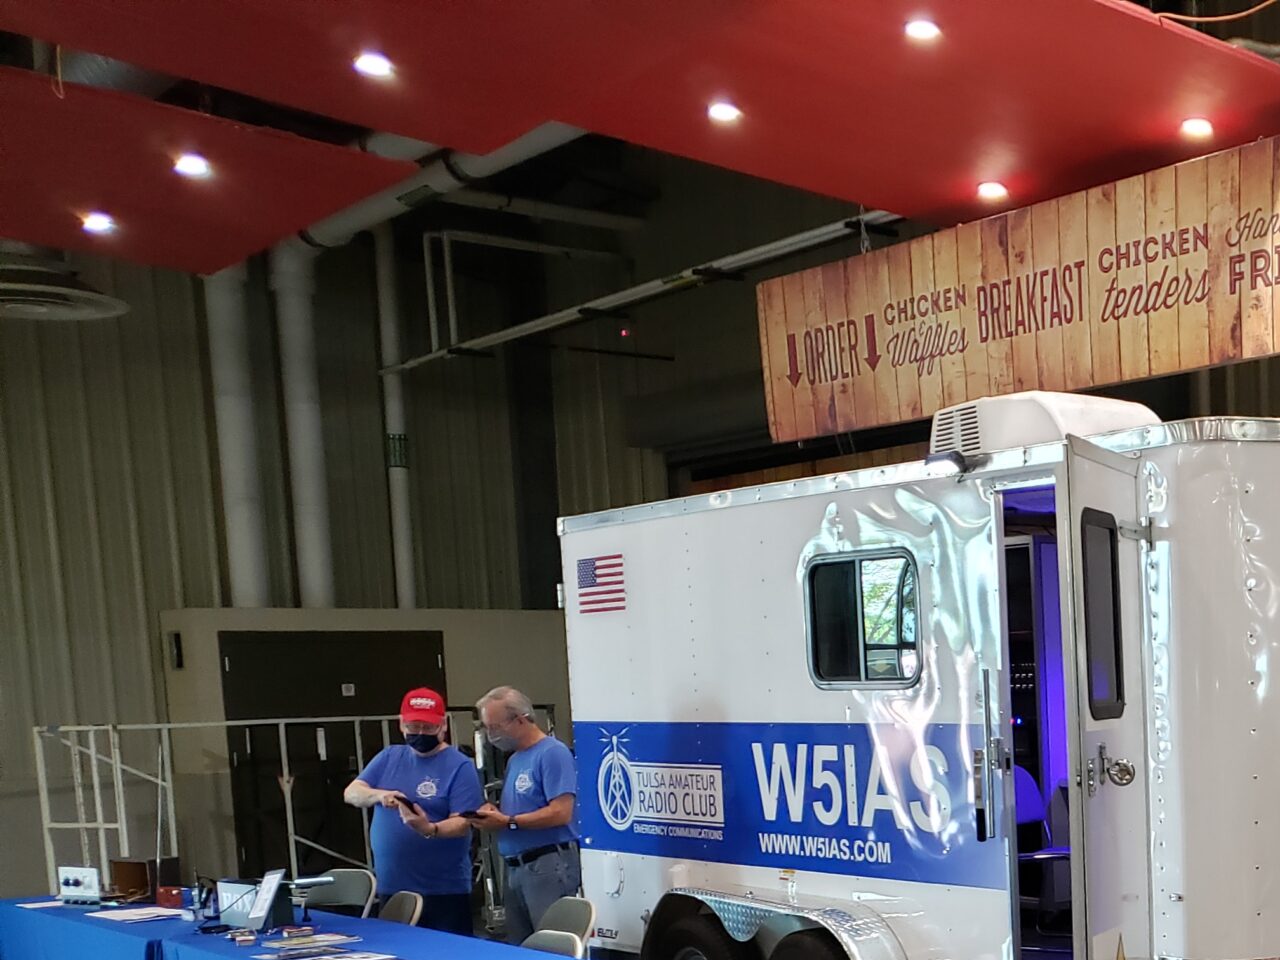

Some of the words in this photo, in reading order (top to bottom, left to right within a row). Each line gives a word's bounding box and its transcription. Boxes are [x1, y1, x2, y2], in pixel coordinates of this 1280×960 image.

[1098, 223, 1209, 273] CHICKEN
[883, 284, 967, 326] CHICKEN
[977, 260, 1085, 343] BREAKFAST
[1101, 265, 1211, 323] tenders
[803, 319, 861, 386] ORDER
[887, 321, 969, 378] Waffles
[636, 771, 666, 789] TULSA
[668, 774, 716, 791] AMATEUR
[639, 791, 678, 815] RADIO
[683, 793, 717, 817] CLUB
[751, 742, 951, 833] W5IAS
[759, 832, 891, 863] WWW.W5IAS.COM
